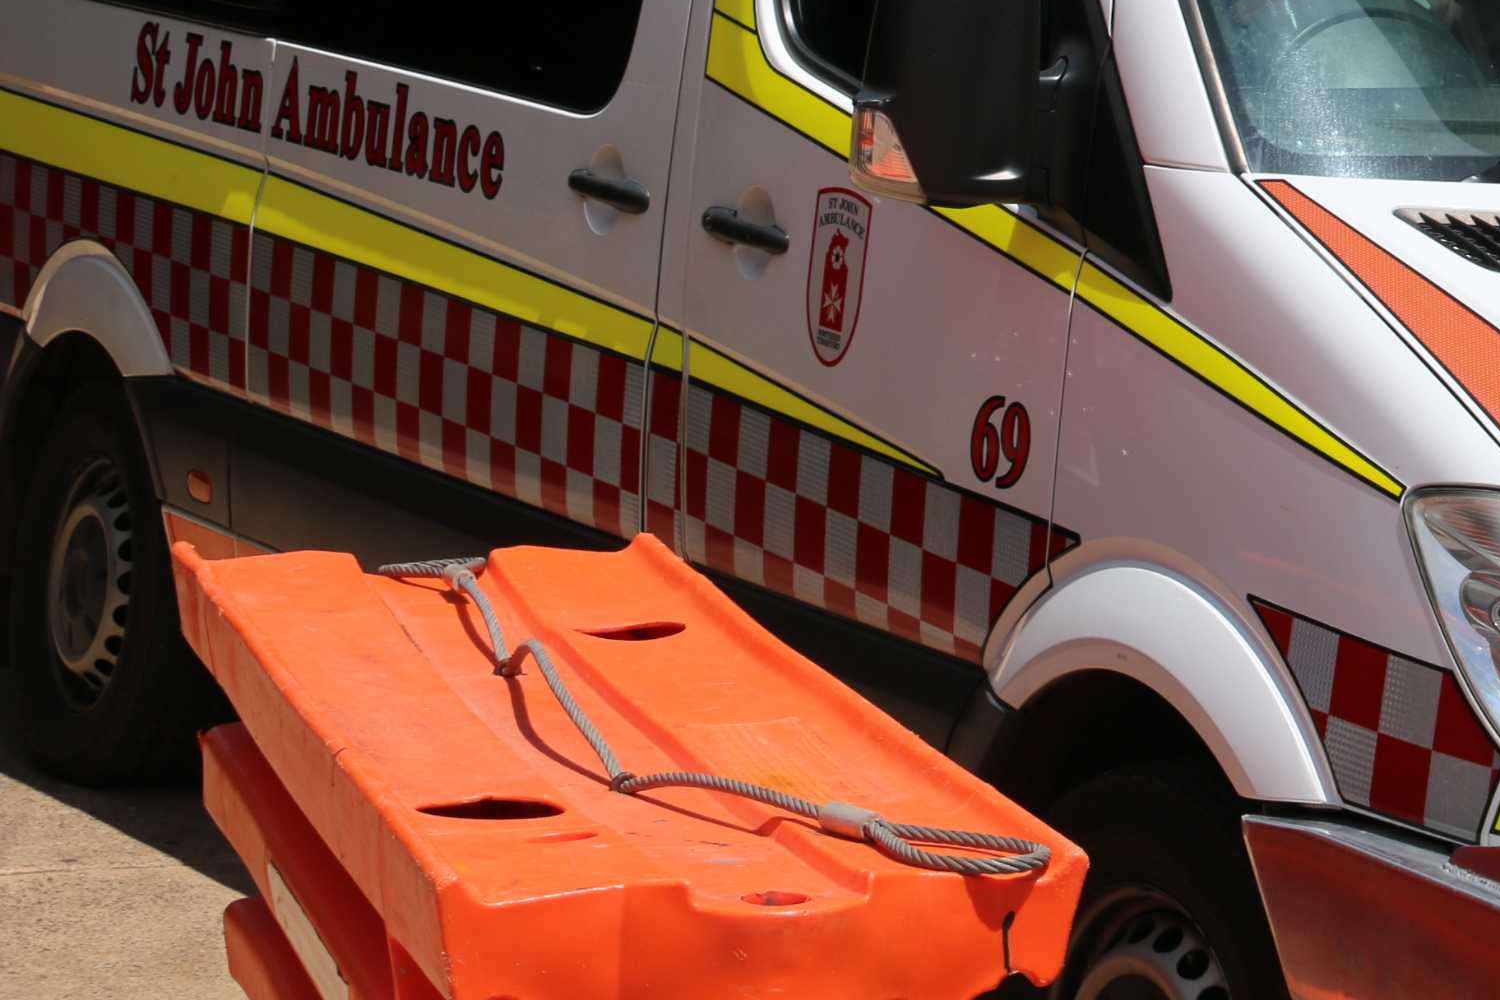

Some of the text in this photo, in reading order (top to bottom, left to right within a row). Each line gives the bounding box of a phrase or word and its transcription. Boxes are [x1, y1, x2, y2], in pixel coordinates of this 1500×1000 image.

[131, 21, 505, 200] St John Ambulance
[819, 212, 865, 240] AMBULANCE
[970, 395, 1031, 489] 69
